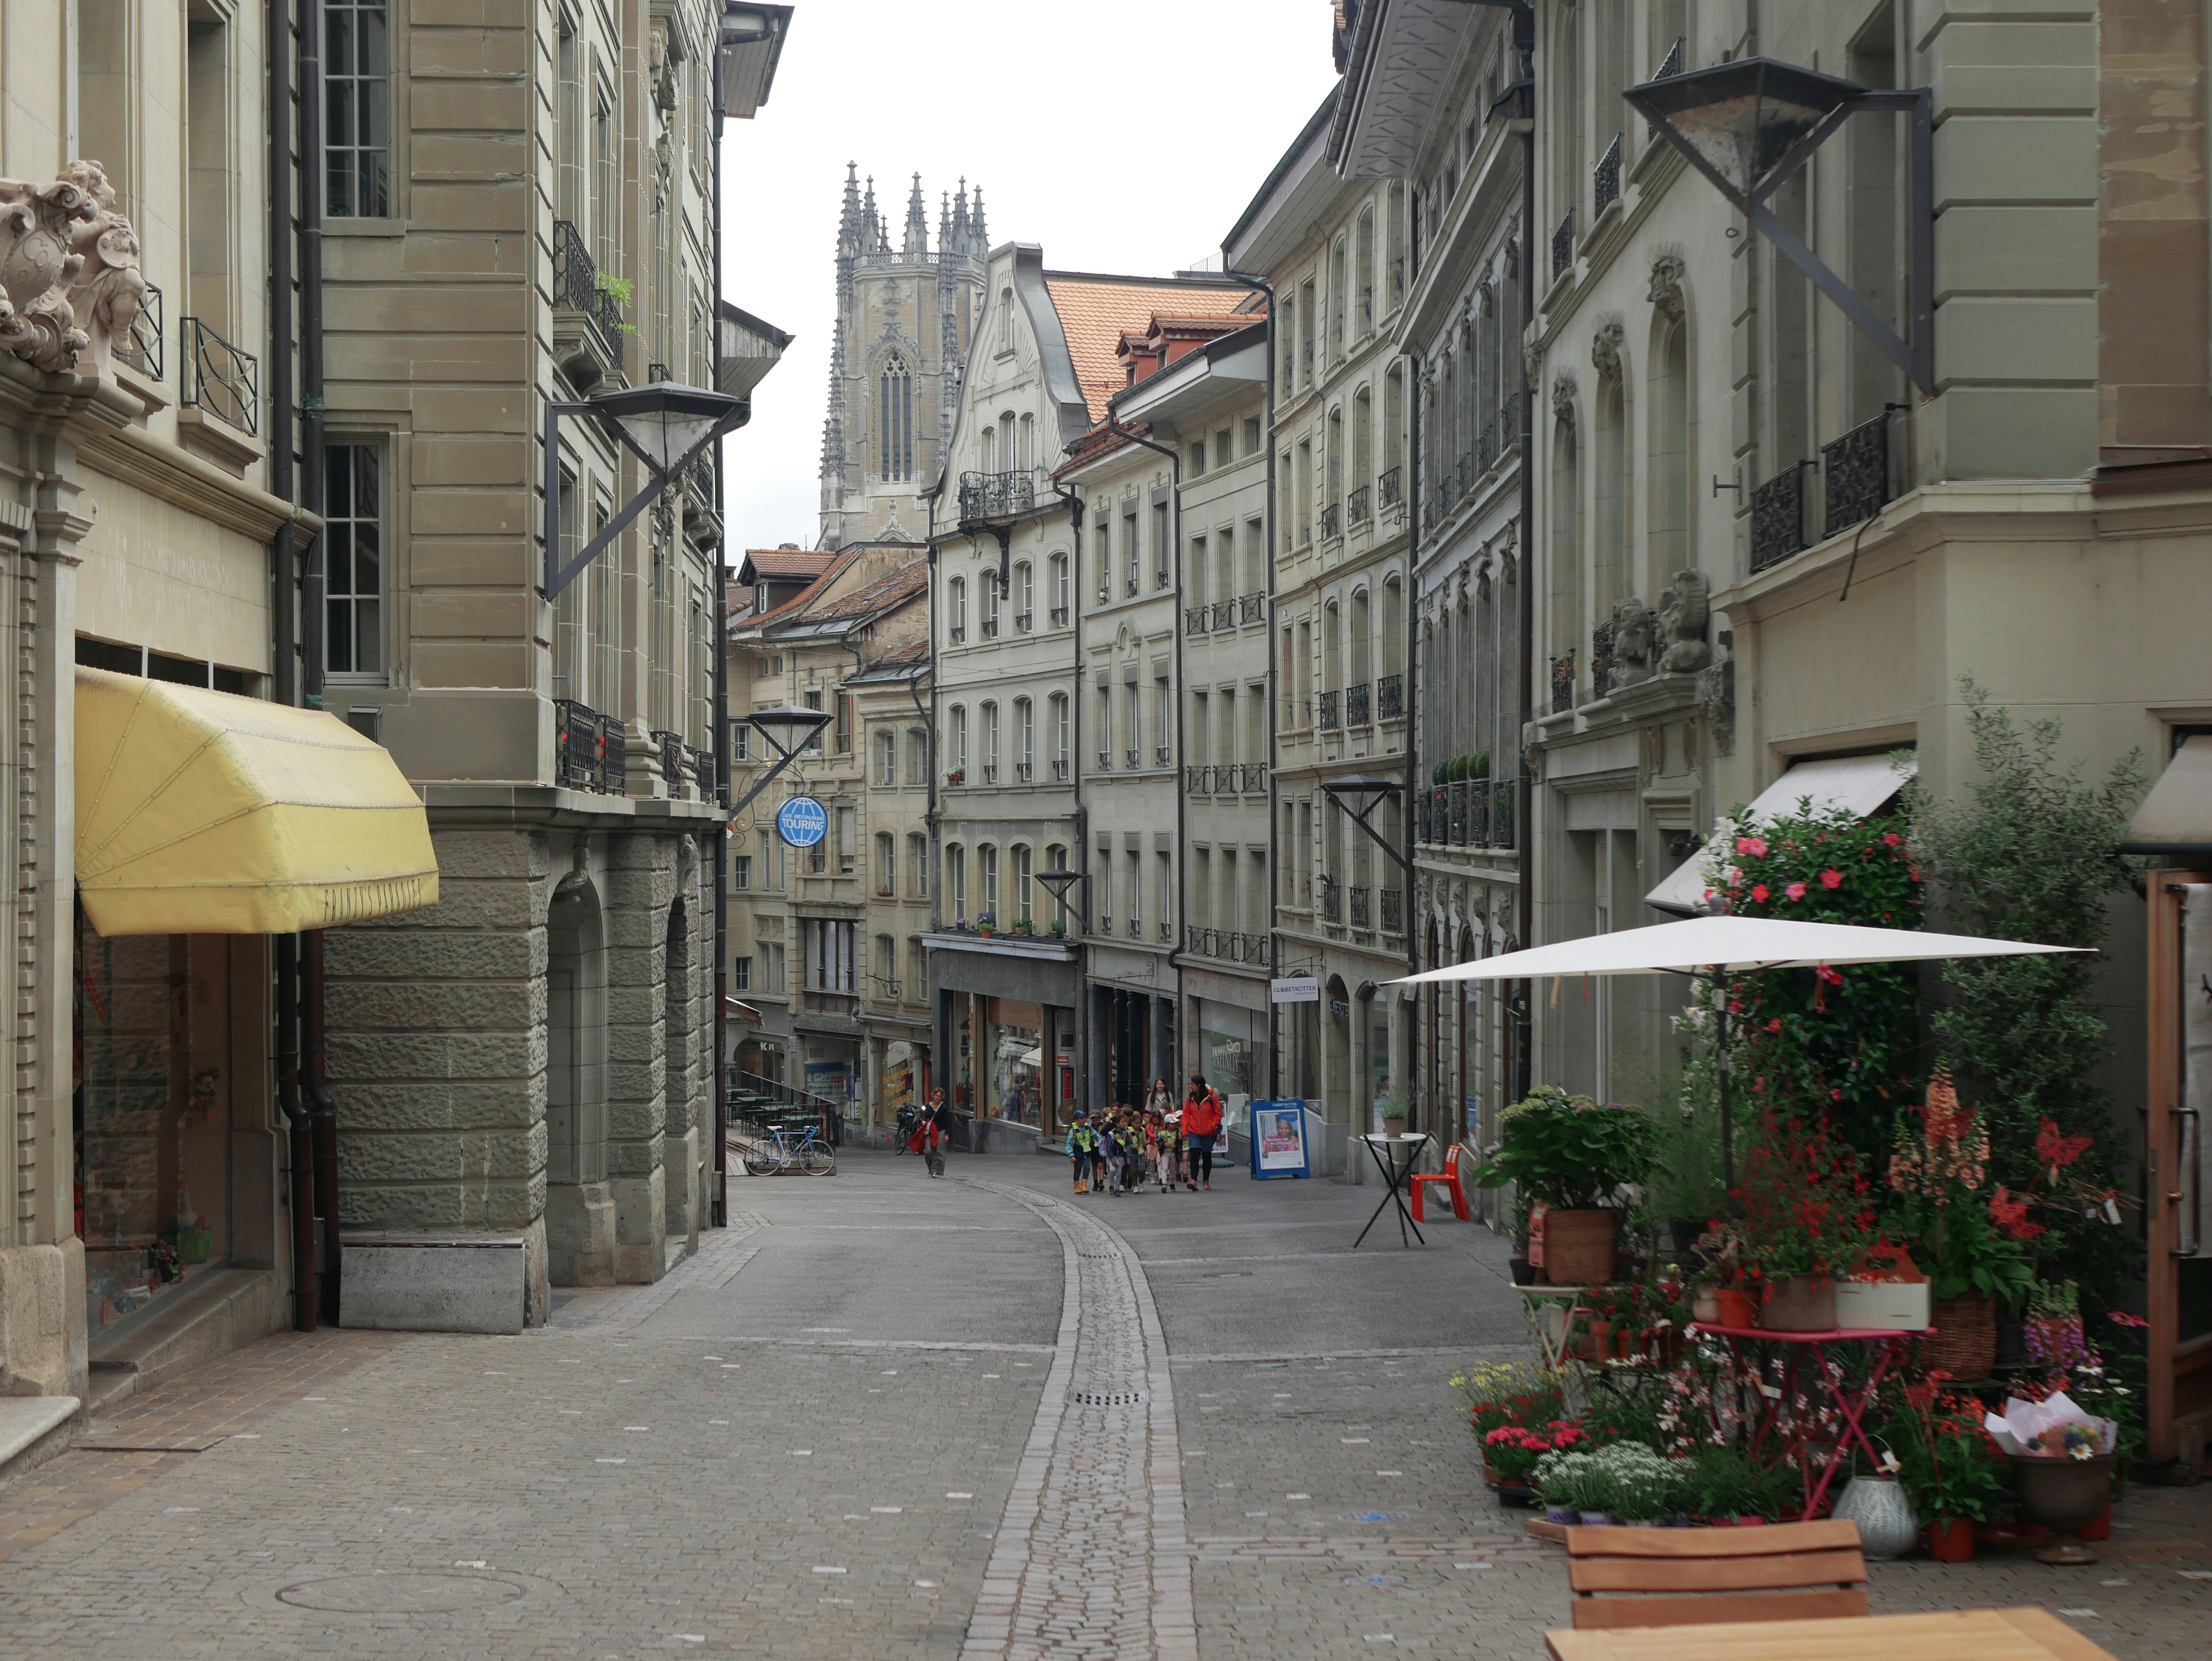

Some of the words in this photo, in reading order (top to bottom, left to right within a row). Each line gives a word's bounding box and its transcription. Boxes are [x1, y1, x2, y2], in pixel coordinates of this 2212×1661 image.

[782, 818, 824, 830] TOURING
[377, 878, 421, 915] PARADIES
[1211, 1046, 1239, 1072] INFINITY
[884, 1087, 895, 1098] TOUT
[896, 1081, 906, 1094] DOIT
